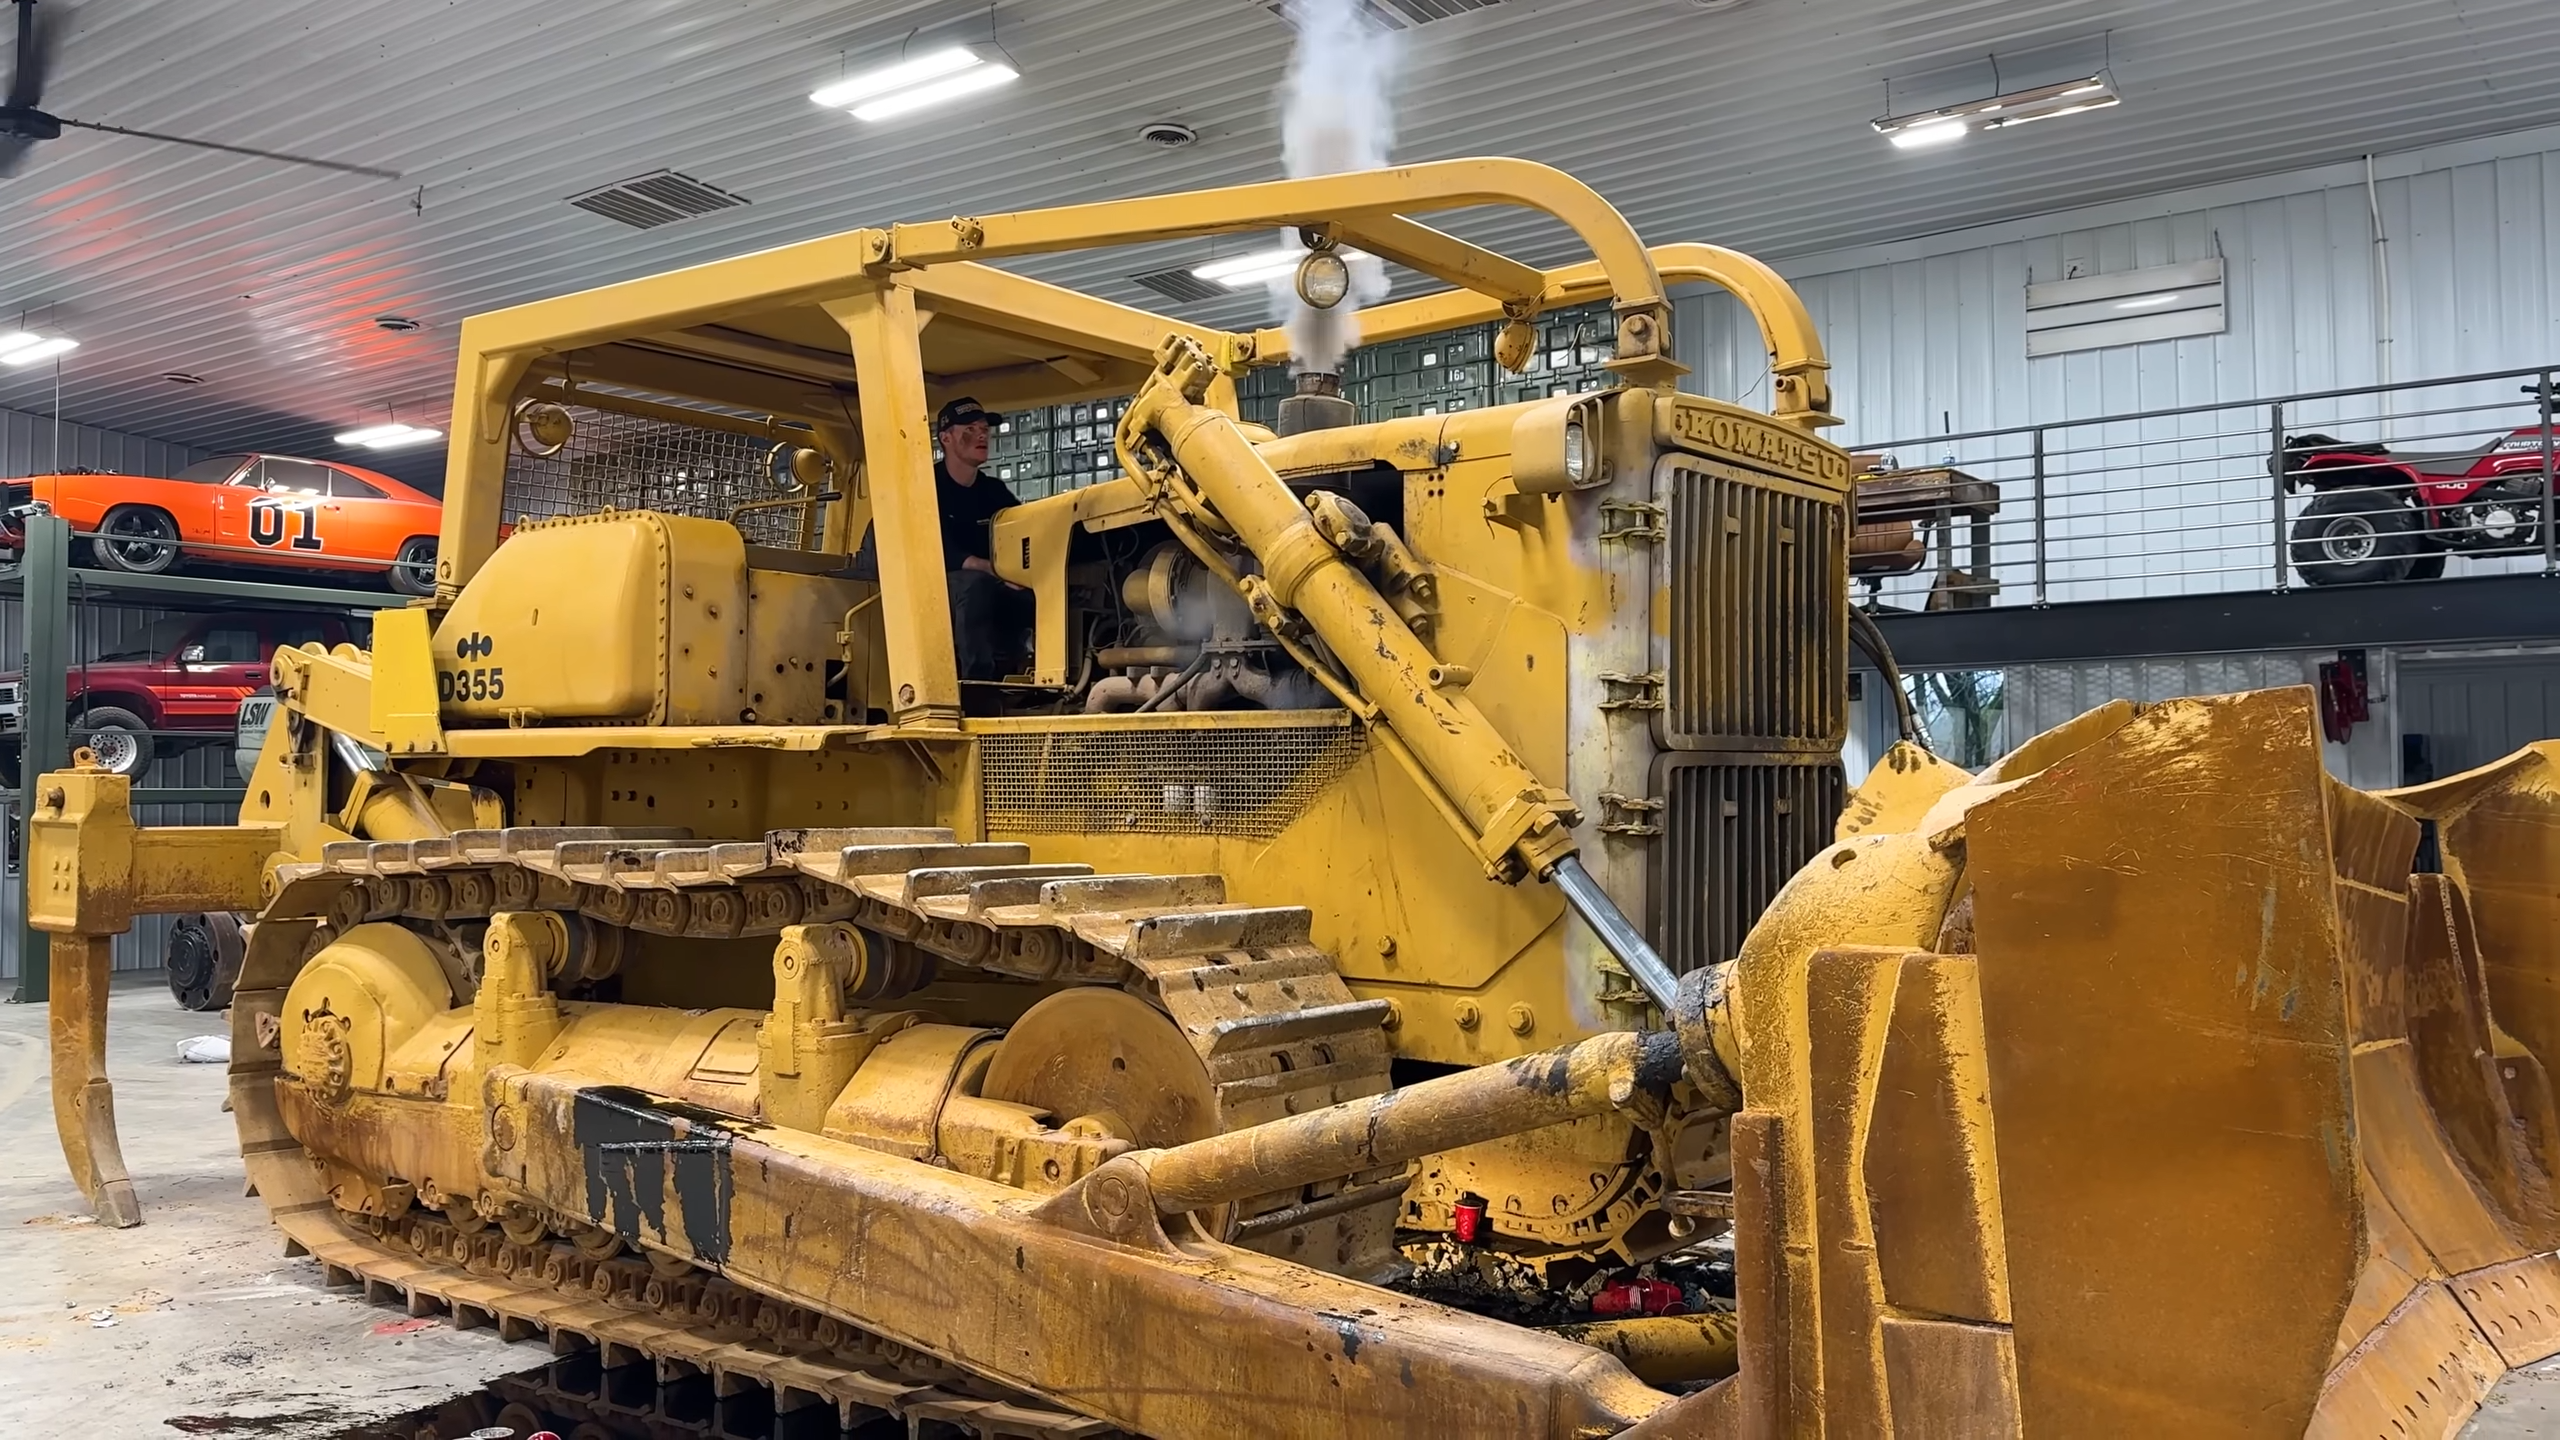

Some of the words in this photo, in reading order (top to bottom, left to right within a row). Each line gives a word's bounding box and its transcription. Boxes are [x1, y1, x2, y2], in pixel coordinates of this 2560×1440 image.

[1685, 410, 1839, 478] KOMATSU
[250, 496, 323, 551] 01
[22, 652, 30, 744] BENDPAK
[438, 667, 504, 702] D355
[240, 702, 272, 726] LSW
